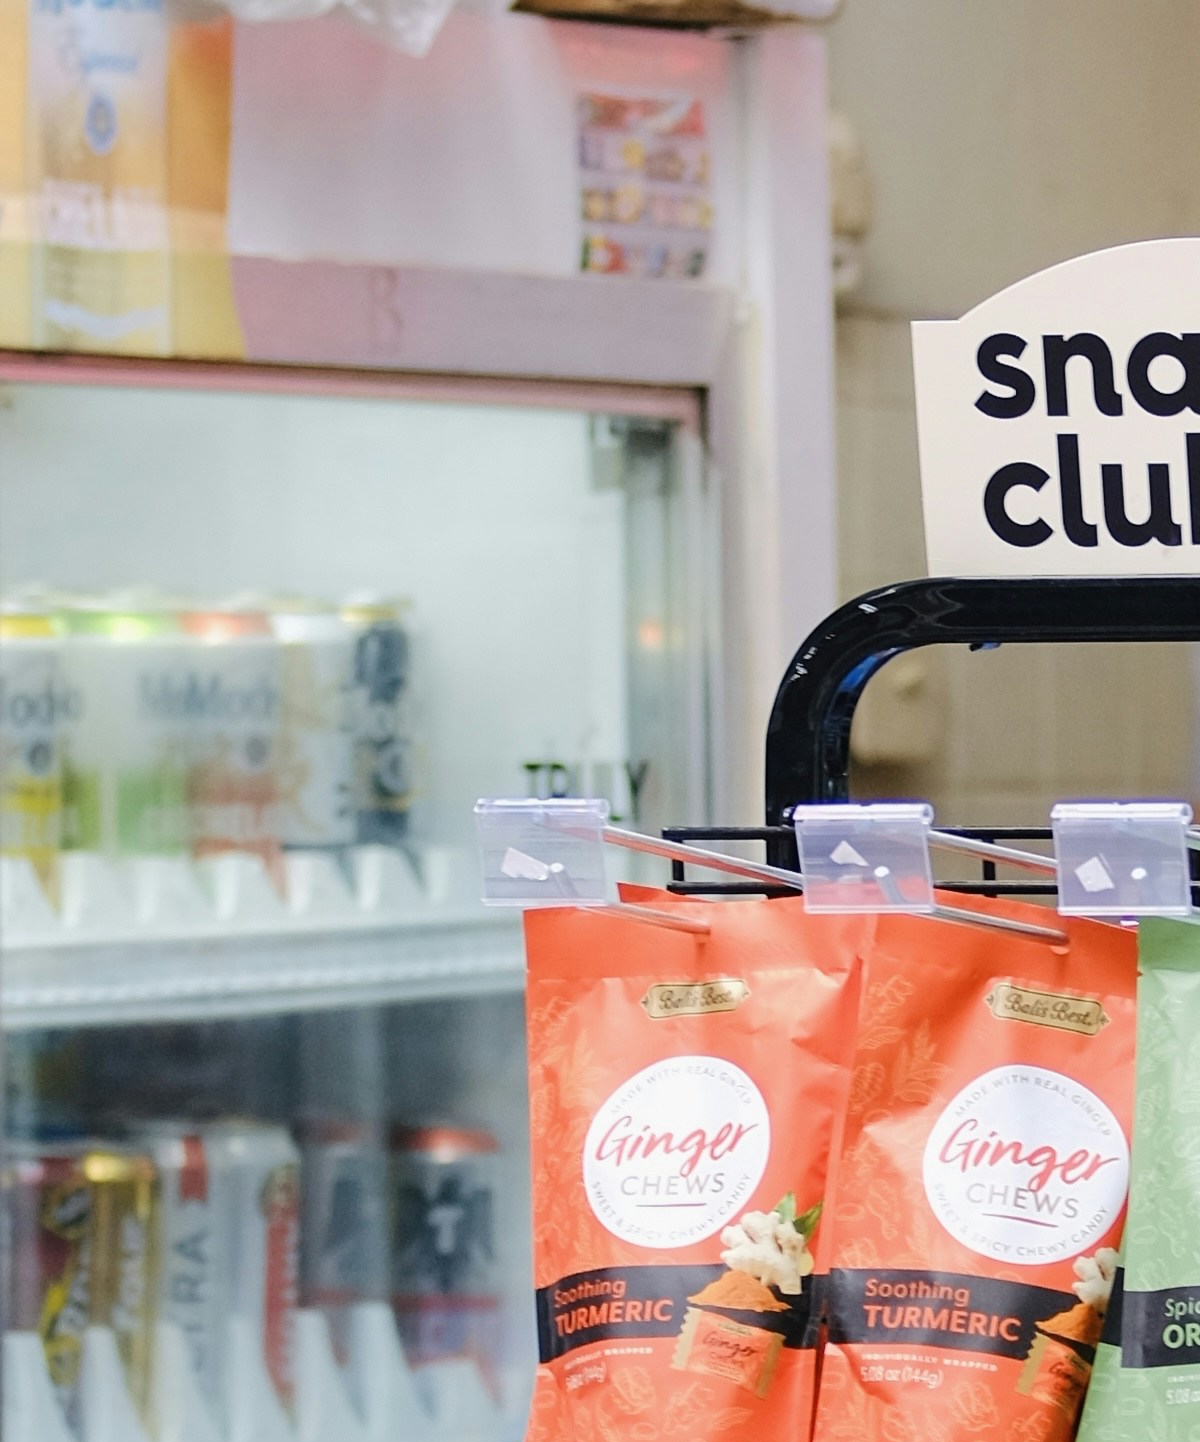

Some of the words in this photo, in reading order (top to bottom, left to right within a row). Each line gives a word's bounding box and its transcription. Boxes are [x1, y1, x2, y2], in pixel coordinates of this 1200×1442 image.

[955, 1091, 989, 1118] MADE
[992, 1075, 1030, 1089] WITH
[1034, 1077, 1069, 1098] REAL
[1072, 1094, 1112, 1136] GINGER
[594, 1115, 759, 1178] Ginger
[939, 1119, 1120, 1193] Ginger
[620, 1172, 726, 1197] CHEWS
[719, 1173, 751, 1216] CANDY
[966, 1183, 1080, 1219] CHEWS
[1018, 1239, 1067, 1257] CHEWY
[1071, 1206, 1110, 1244] CANDY
[554, 1279, 627, 1308] Soothing
[865, 1278, 970, 1307] Soothing
[555, 1299, 673, 1337] TURMERIC
[863, 1305, 1022, 1342] TURMERIC
